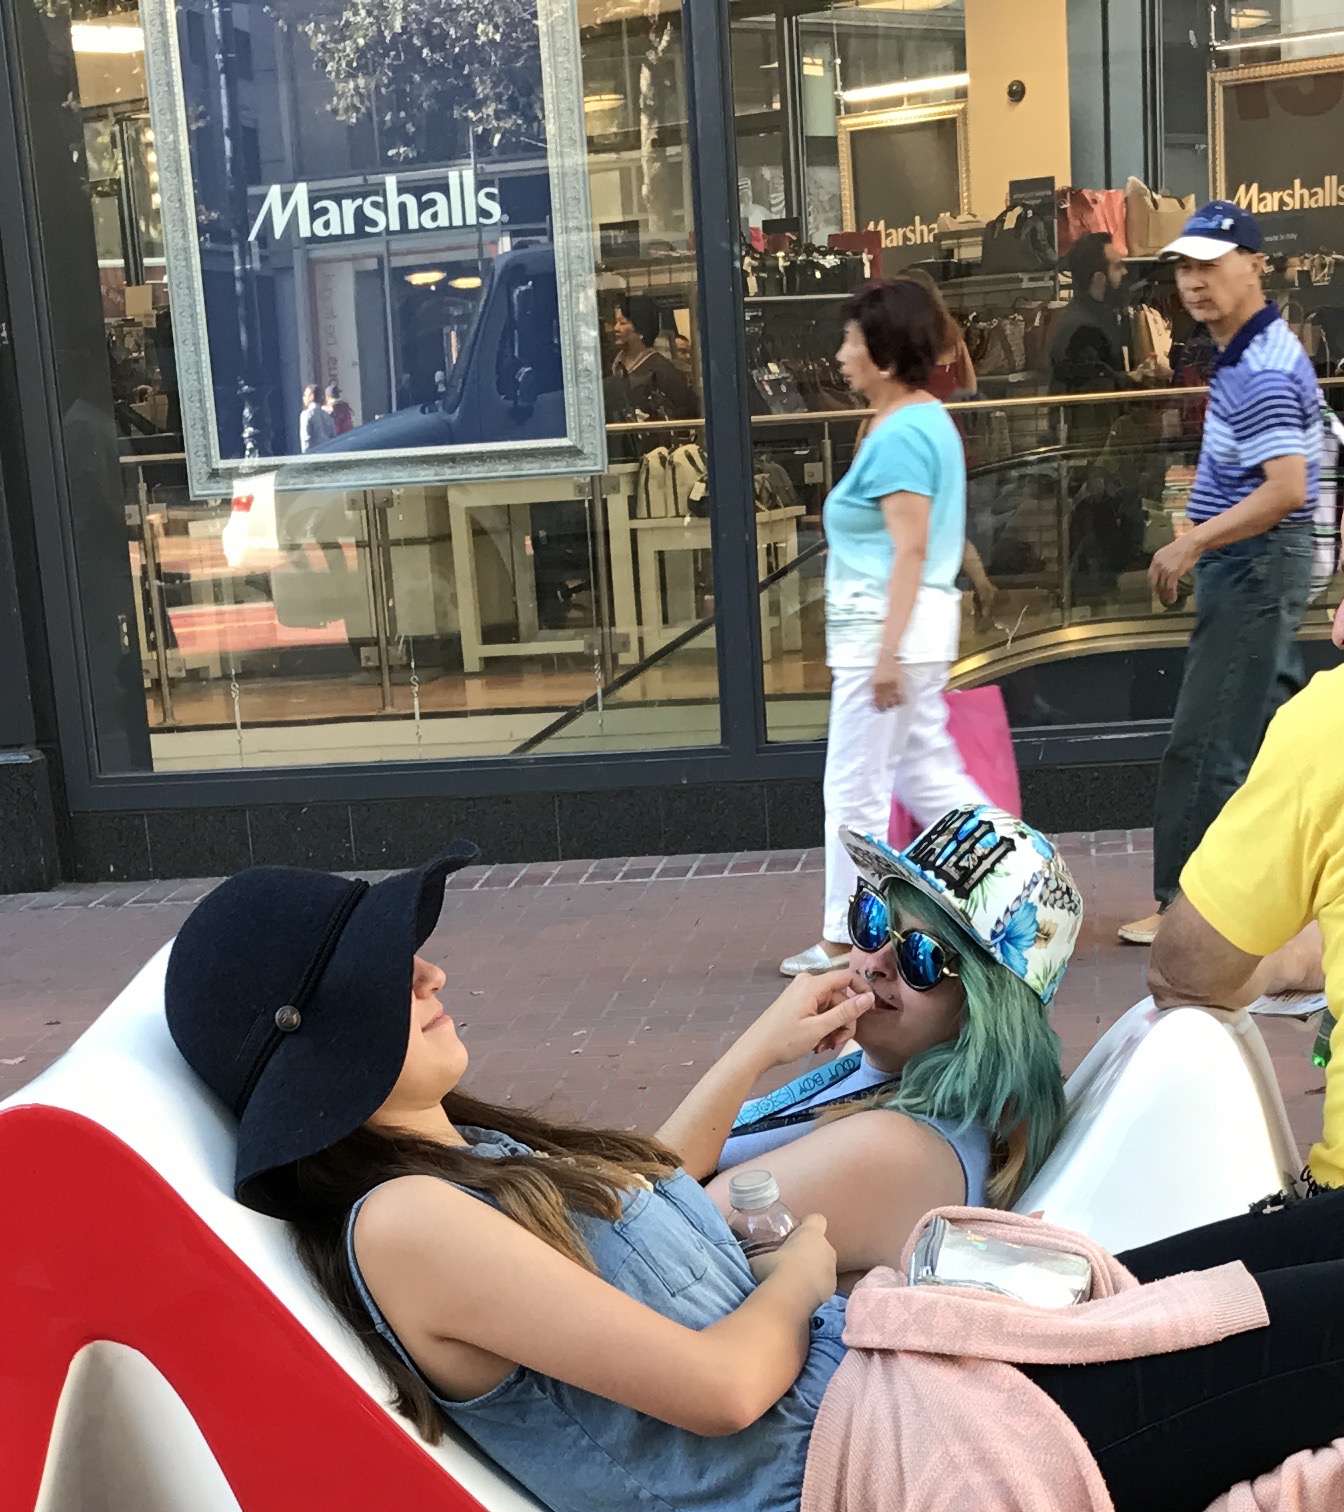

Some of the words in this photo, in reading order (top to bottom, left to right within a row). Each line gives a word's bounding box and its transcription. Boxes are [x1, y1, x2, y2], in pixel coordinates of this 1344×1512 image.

[247, 169, 502, 241] Marshalls
[828, 1057, 857, 1080] OUT
[798, 1072, 825, 1096] BOY
